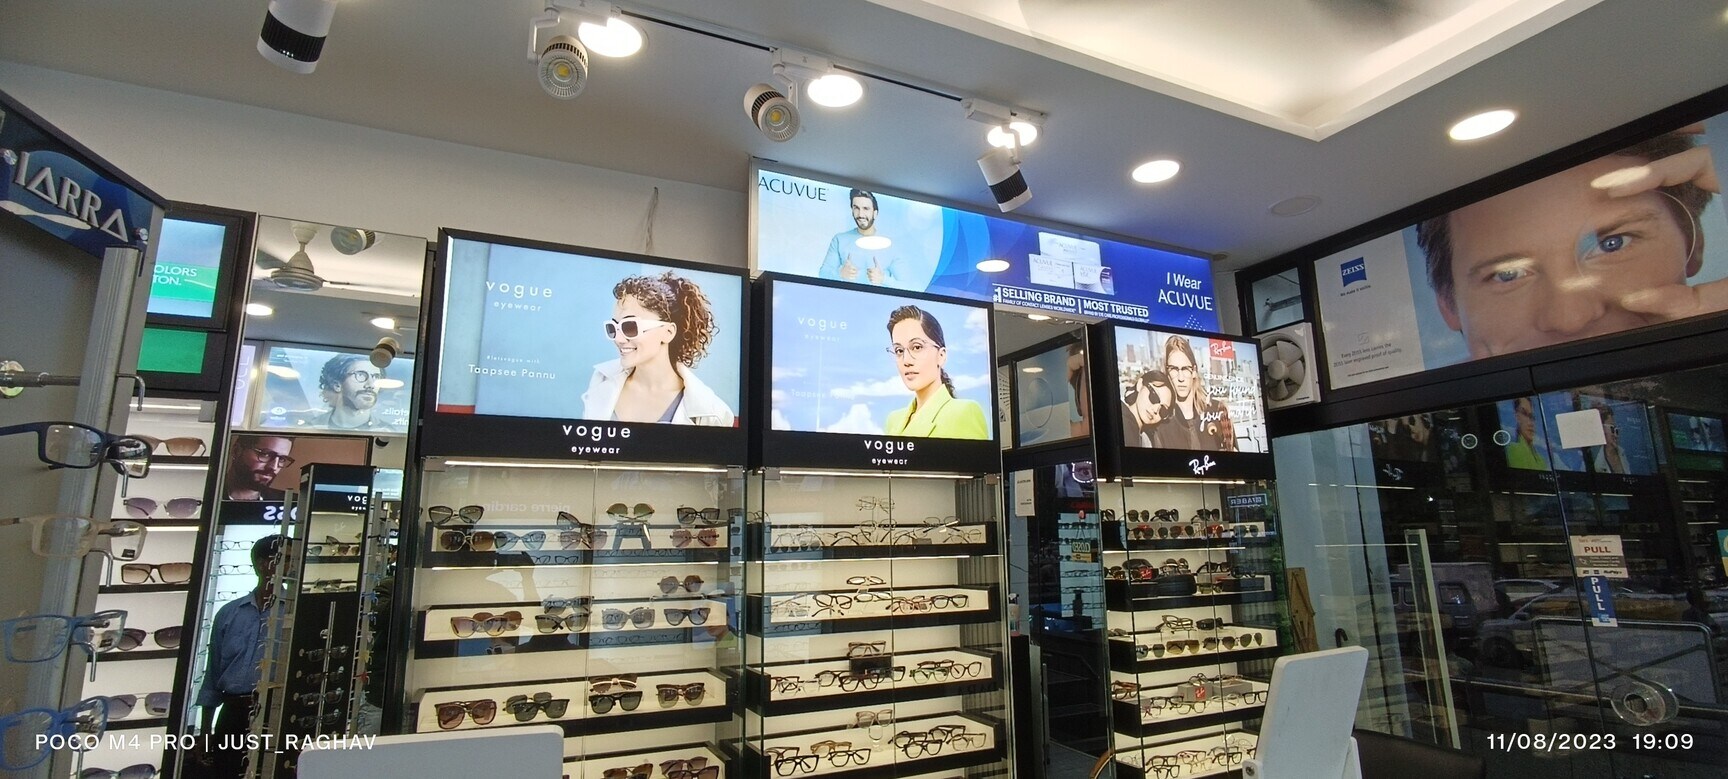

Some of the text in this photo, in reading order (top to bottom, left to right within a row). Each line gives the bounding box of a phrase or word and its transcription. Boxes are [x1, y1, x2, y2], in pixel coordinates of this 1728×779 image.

[757, 176, 827, 202] ACUVUE
[1342, 263, 1364, 276] ZEISS
[1166, 272, 1202, 290] I Wear
[486, 281, 553, 299] vogue
[1002, 287, 1042, 303] SELLING
[1043, 293, 1076, 307] BRAND
[493, 301, 542, 313] eyewear
[1158, 288, 1213, 311] ACUVUE
[1083, 299, 1149, 318] MOST TRUSTED
[797, 316, 847, 331] vogue
[468, 364, 556, 380] Taapsee Pannu
[562, 424, 631, 441] vogue
[571, 446, 620, 455] eyewear
[864, 440, 915, 454] vogue
[871, 458, 908, 466] eyewear
[1584, 546, 1612, 554] PULL
[1591, 577, 1605, 610] PULL
